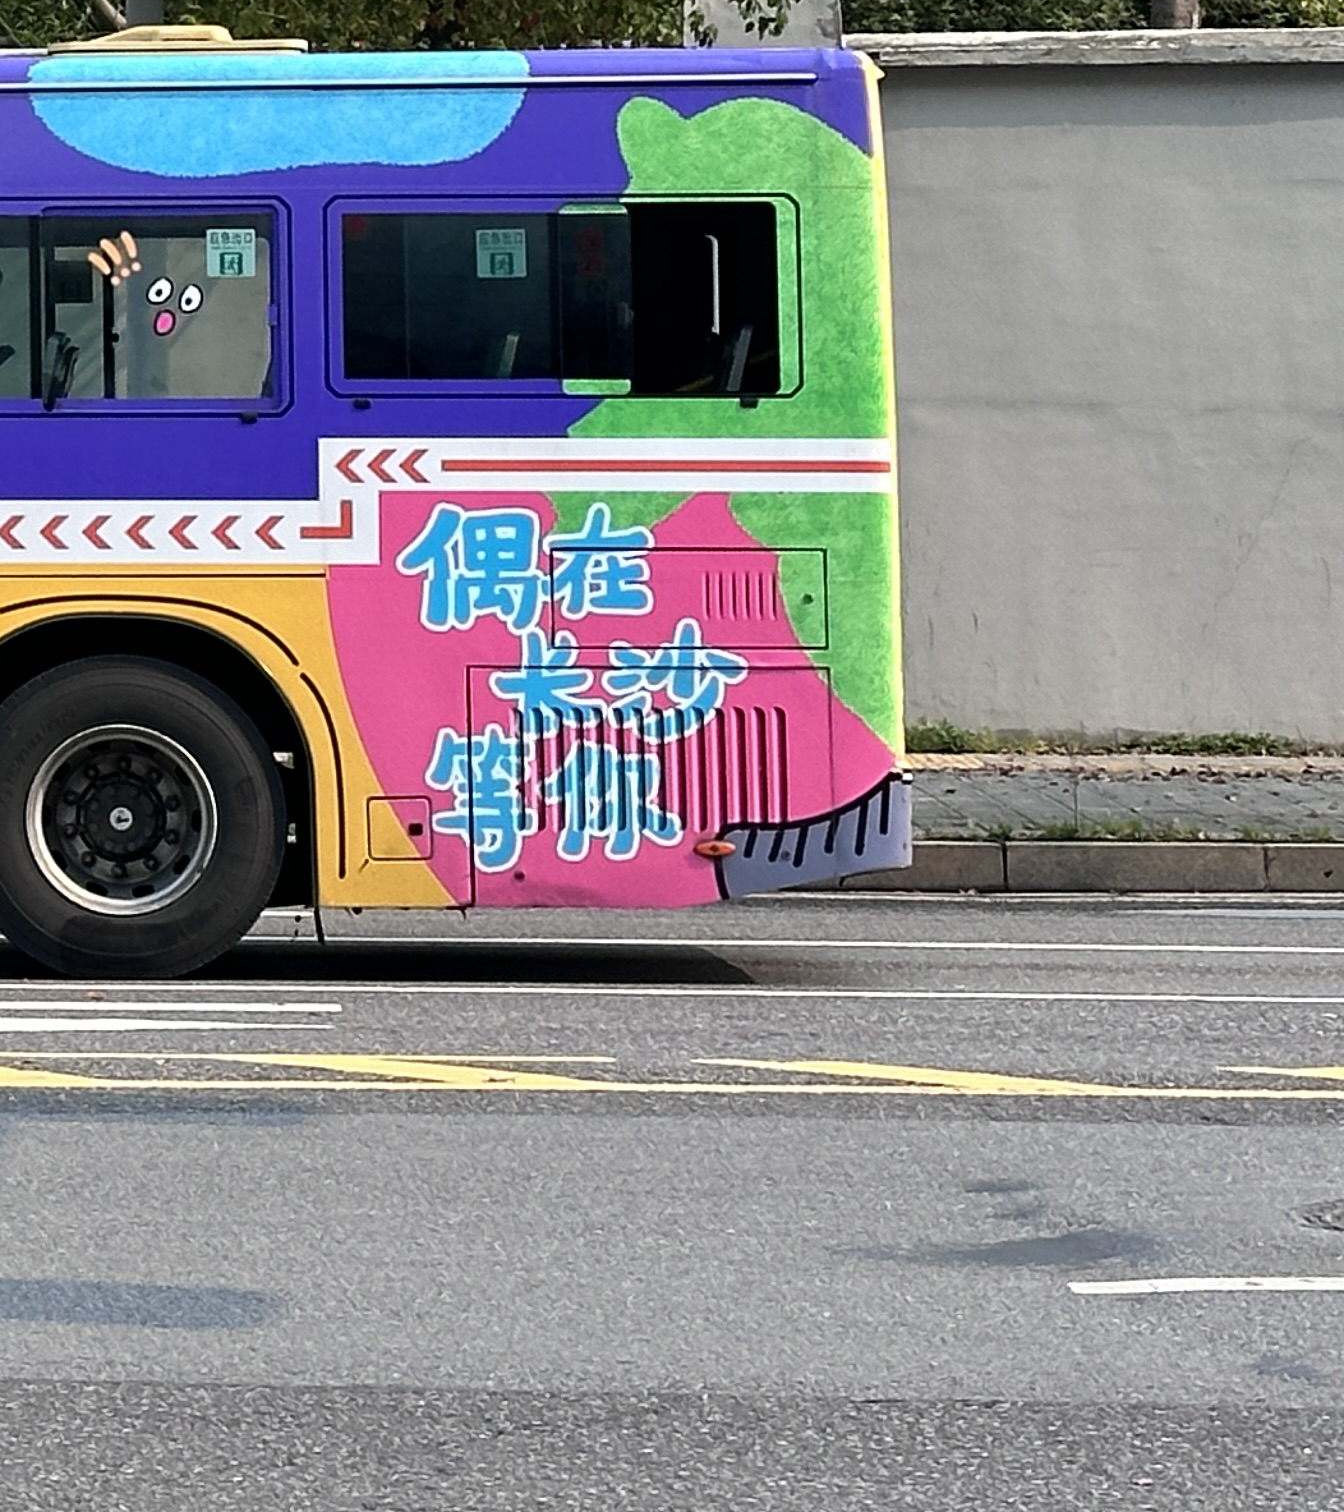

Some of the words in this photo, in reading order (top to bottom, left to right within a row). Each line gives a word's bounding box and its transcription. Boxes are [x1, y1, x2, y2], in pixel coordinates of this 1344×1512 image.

[396, 501, 655, 631] 偶在
[489, 618, 748, 743] 长沙
[425, 724, 683, 873] 等你
